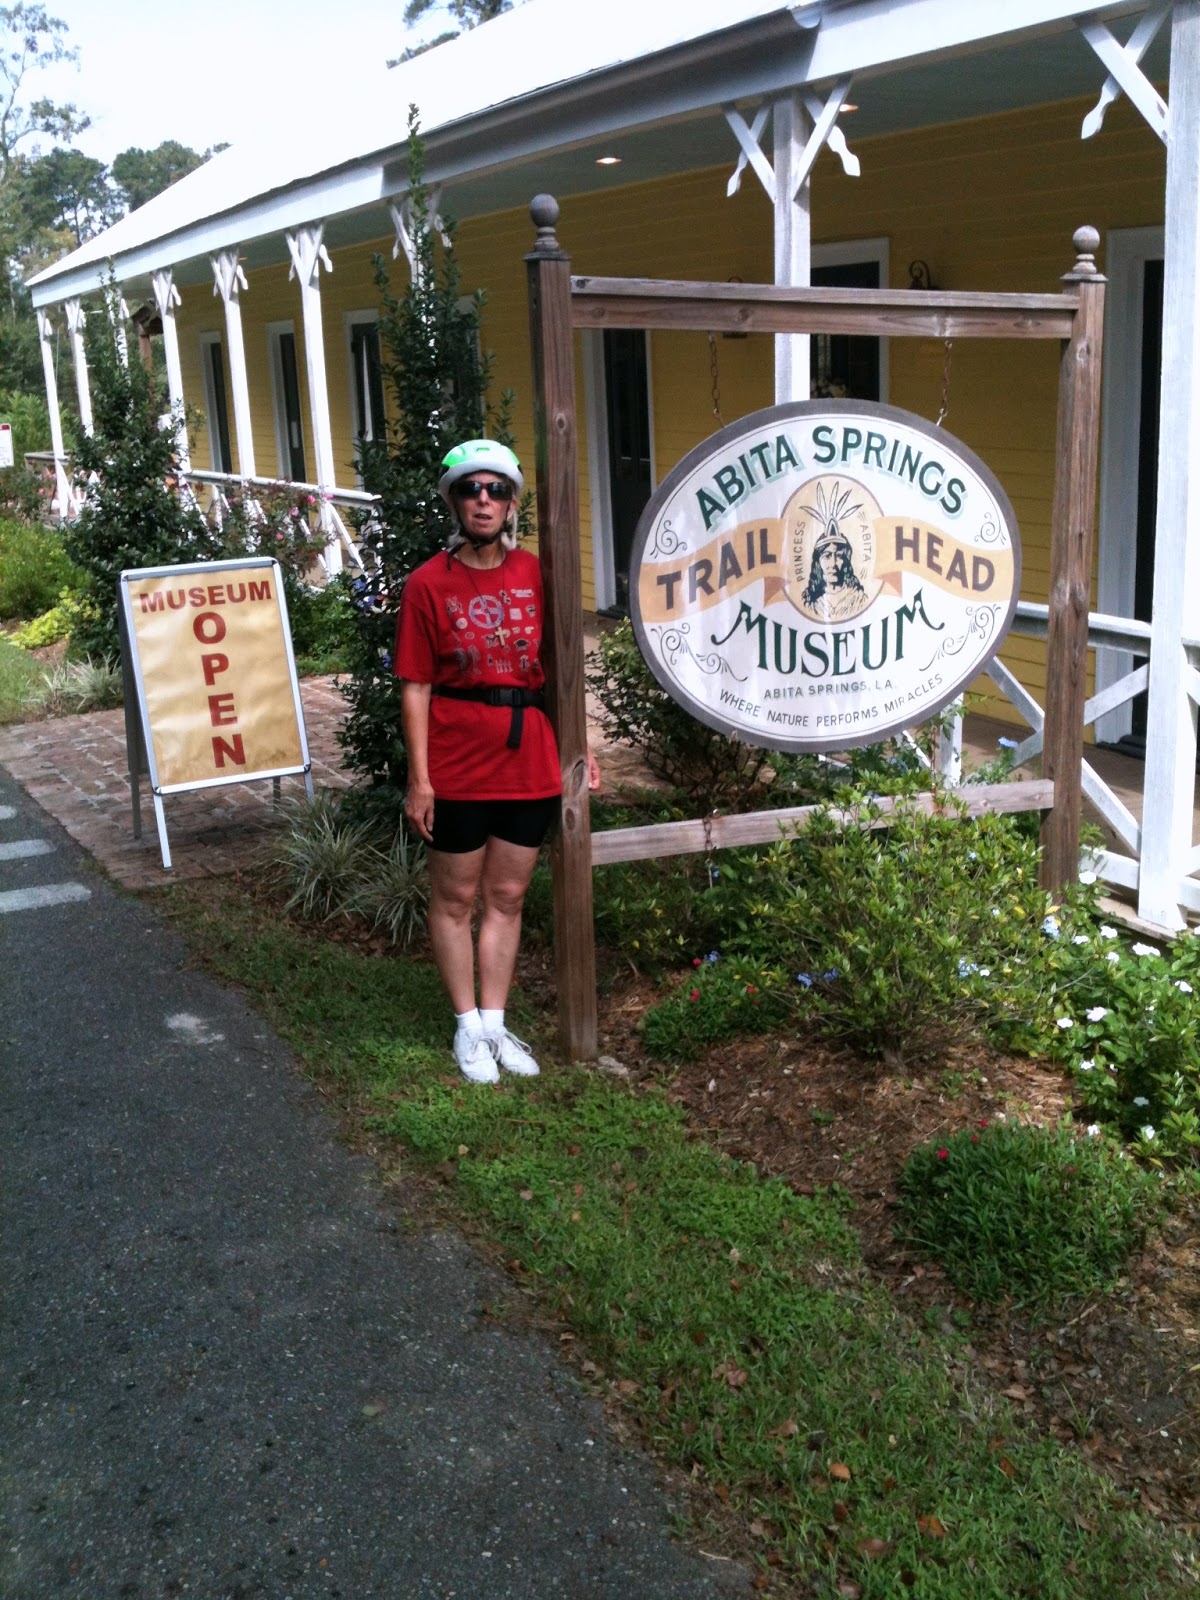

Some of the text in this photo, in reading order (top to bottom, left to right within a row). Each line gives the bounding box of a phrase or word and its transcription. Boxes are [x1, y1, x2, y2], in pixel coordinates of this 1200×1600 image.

[696, 424, 967, 531] ABITA SPRINGS
[656, 526, 996, 610] TRAIL HEAD
[793, 520, 872, 582] PRINCESS ABITA
[139, 580, 272, 613] MUSEUM
[711, 587, 945, 679] MUSEUM
[192, 611, 247, 769] OPEN
[720, 673, 943, 728] WHERE NATURE PERFORMS MIRACLES
[763, 687, 802, 700] ABITA
